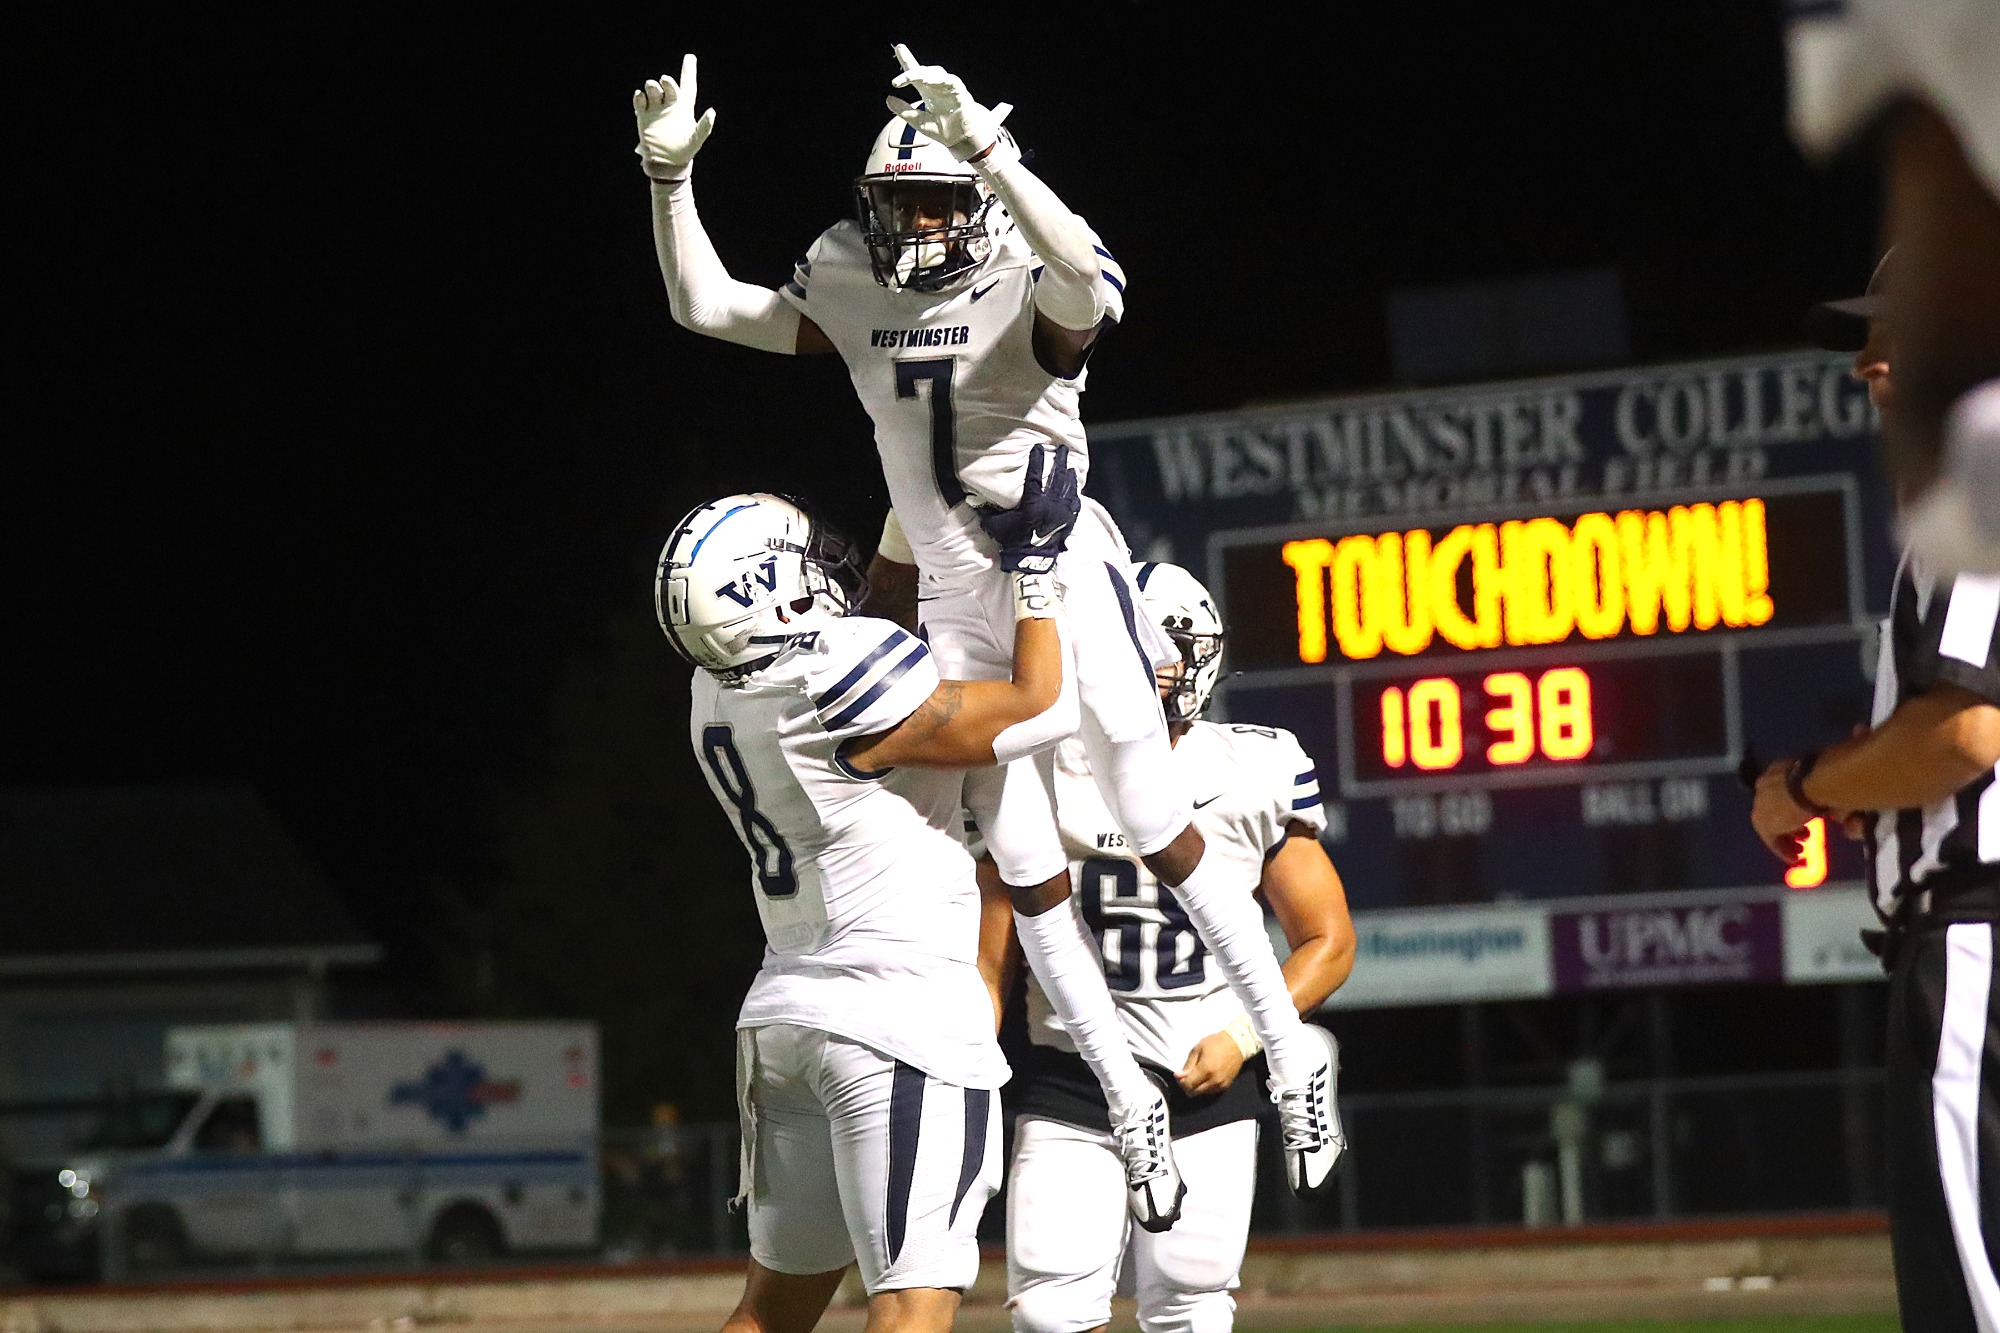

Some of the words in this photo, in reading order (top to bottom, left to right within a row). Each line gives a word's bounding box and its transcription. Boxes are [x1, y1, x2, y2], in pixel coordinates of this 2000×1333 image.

[884, 162, 922, 173] Riddell
[870, 326, 969, 349] WESTMINSTER
[892, 356, 967, 510] 7
[1150, 392, 1585, 503] WESTMINSTER
[1613, 364, 1880, 457] COLLEG
[1282, 497, 1775, 664] TOUCHDOWN!
[1381, 676, 1463, 772] 10
[1482, 666, 1595, 767] 38
[702, 722, 799, 900] 8
[1581, 781, 1655, 828] BALL
[1659, 777, 1710, 822] ON
[1577, 904, 1751, 968] UPMC
